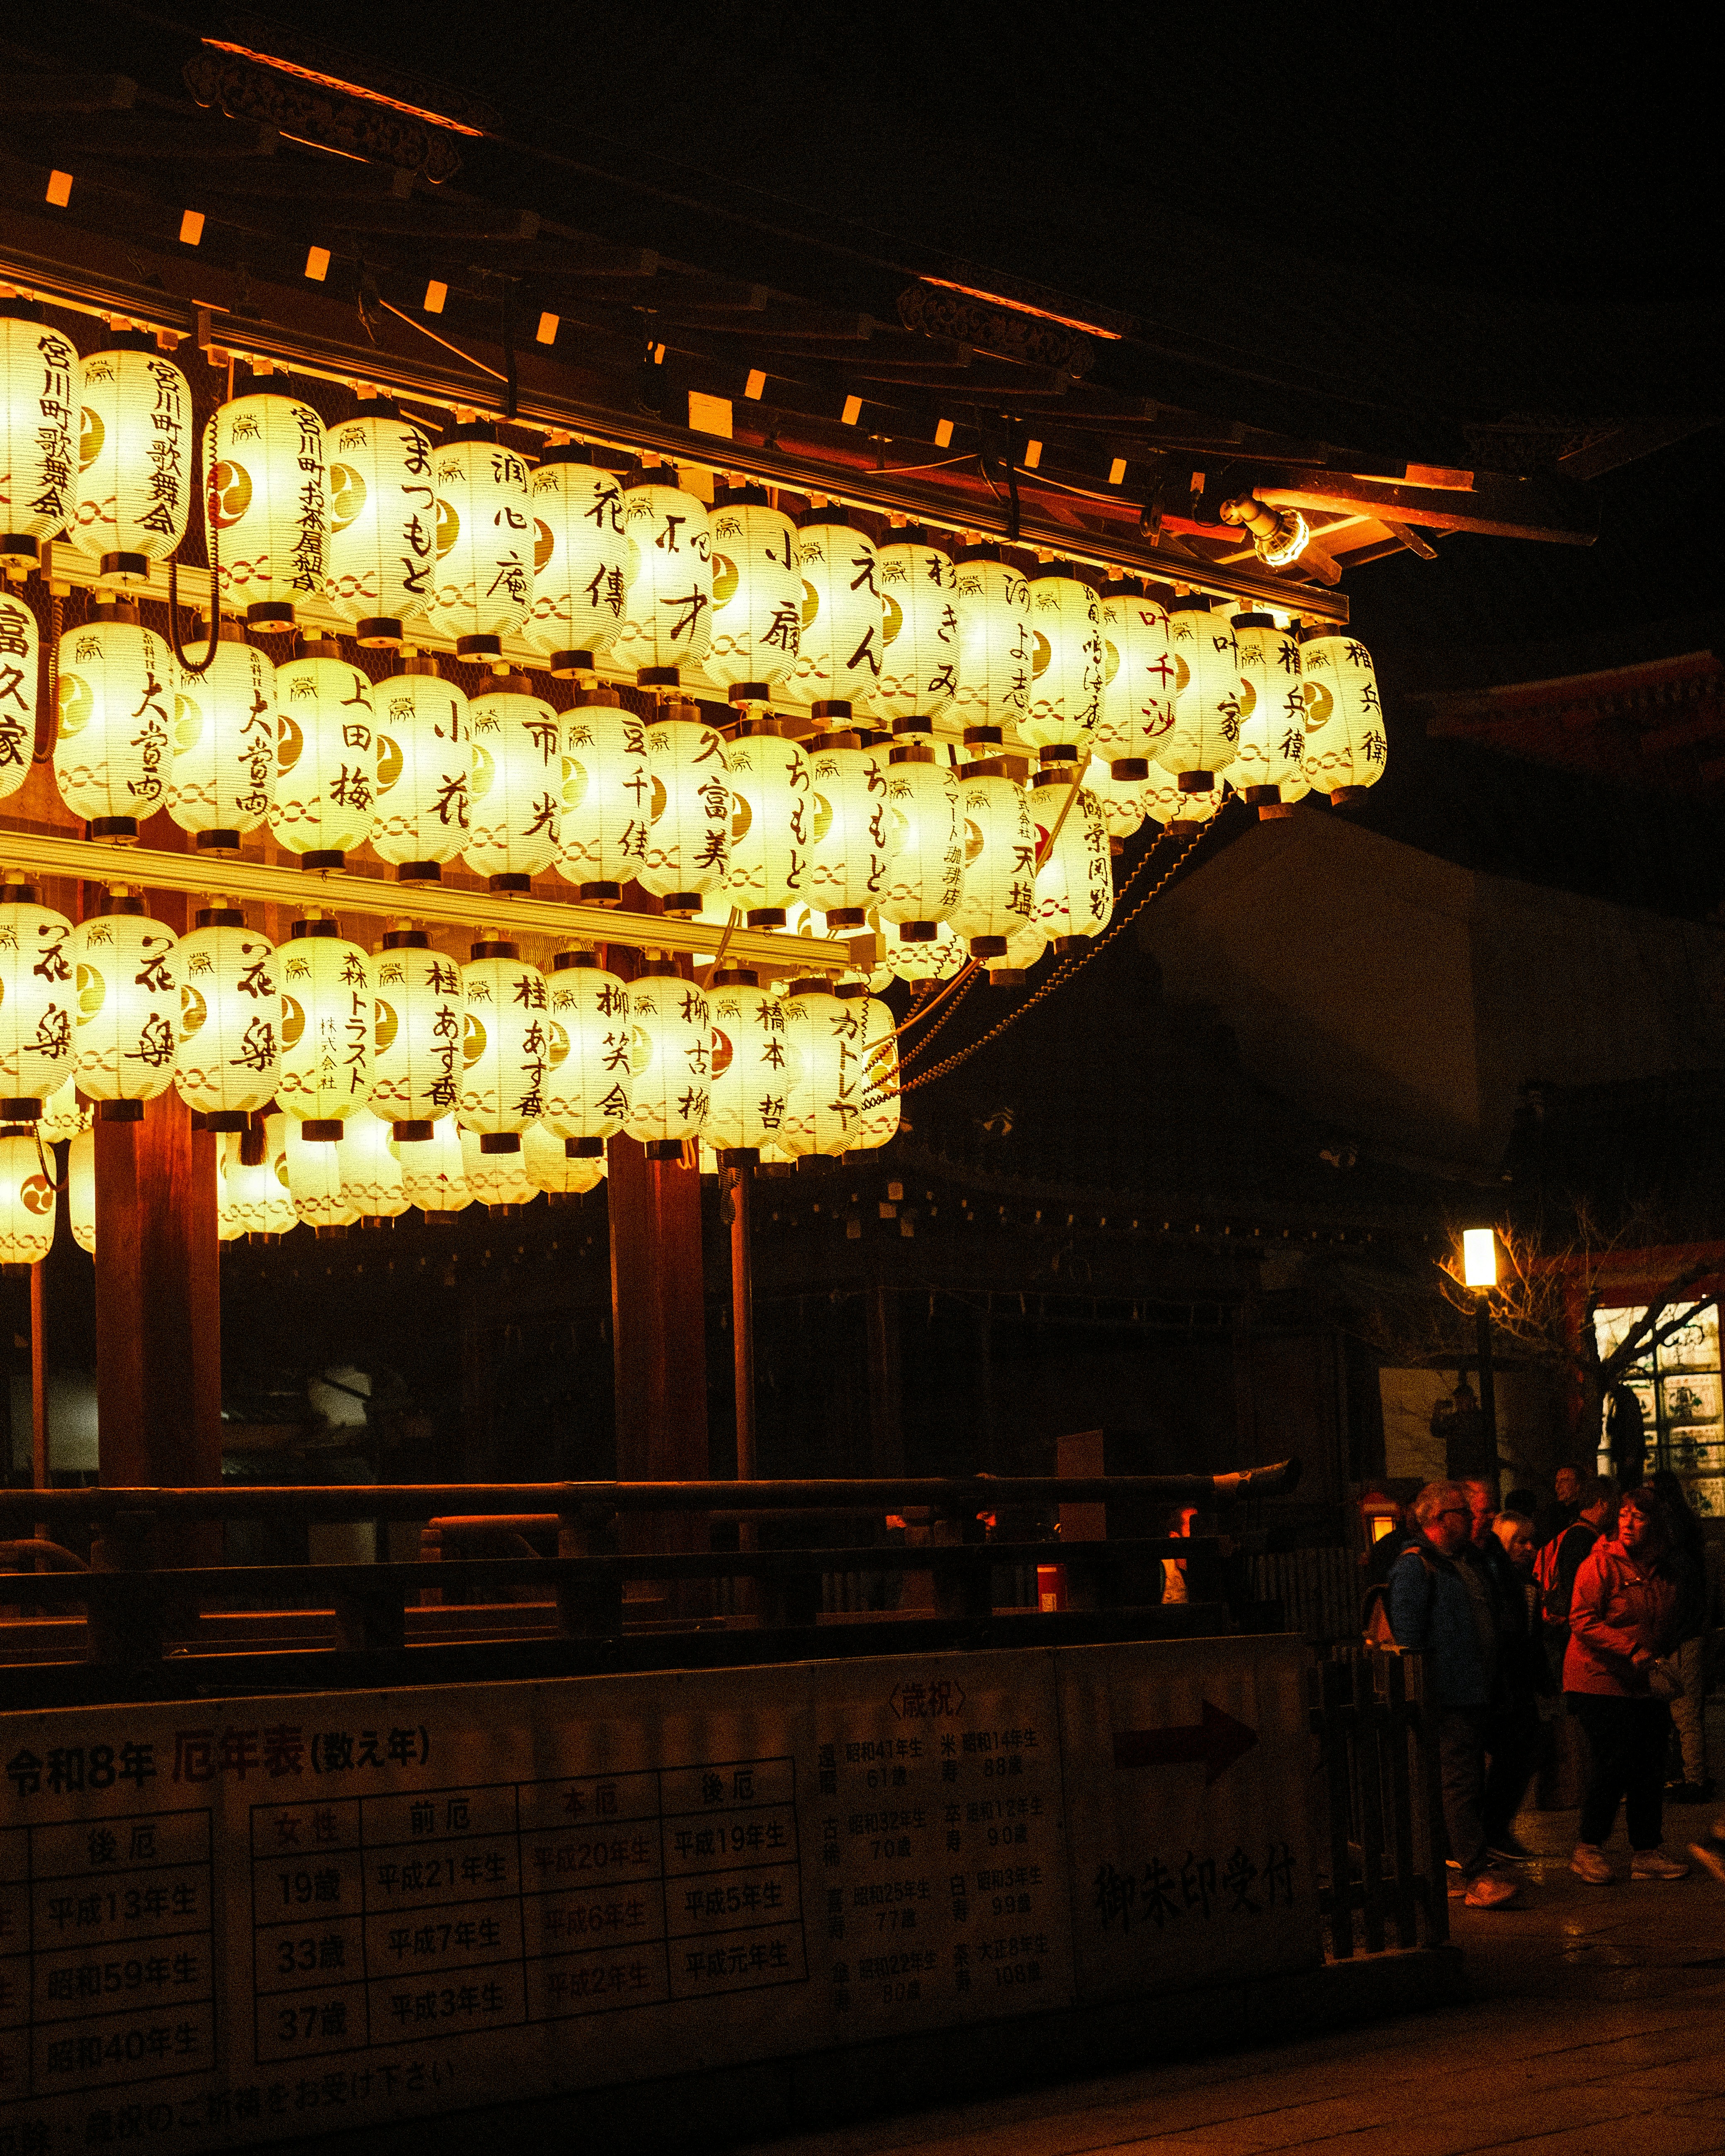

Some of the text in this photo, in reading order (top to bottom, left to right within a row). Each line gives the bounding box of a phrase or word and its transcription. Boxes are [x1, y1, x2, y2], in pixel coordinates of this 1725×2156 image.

[25, 335, 73, 518] 宮川町歌舞会
[134, 361, 182, 536] 宮川町歌舞会
[289, 406, 326, 592] 宮川町お茶屋組合
[398, 428, 435, 595] まつもと
[759, 527, 800, 659] 小扇
[845, 544, 883, 677] えん
[1138, 607, 1176, 738] 叶千沙
[329, 673, 374, 811] 上田梅
[428, 700, 470, 829] 小花
[521, 710, 560, 845] 市光
[691, 731, 732, 875] 久富美
[938, 772, 962, 906] スマート珈琲店
[338, 952, 368, 1095] 森トラスト
[420, 960, 460, 1107] 桂あす香
[319, 1017, 337, 1090] 株式会社
[511, 975, 548, 1119] 桂あす香
[594, 983, 631, 1120] 柳笑会
[756, 998, 786, 1130] 橋本哲
[827, 1007, 859, 1131] カトレヤ
[6, 1724, 430, 1798] 令和8年 厄年表 (数え年)
[845, 1737, 924, 1763] 昭和41年生
[962, 1727, 1039, 1753] 昭和14年生
[866, 1765, 907, 1789] 61歳
[983, 1754, 1023, 1777] 88歳
[562, 1783, 618, 1820] 本厄
[702, 1770, 754, 1804] 後厄
[274, 1808, 339, 1845] 女性
[410, 1798, 471, 1835] 前厄
[848, 1808, 927, 1836] 昭和32年生
[966, 1795, 1044, 1822] 昭和12年生
[87, 1824, 157, 1865] 後厄
[674, 1820, 787, 1860] 平成19年生
[870, 1836, 911, 1860] 70歳
[987, 1823, 1028, 1846] 90歳
[377, 1852, 507, 1894] 平成21年生
[535, 1835, 651, 1877] 平成20年生
[278, 1867, 341, 1904] 19歳
[853, 1877, 931, 1907] 昭和25年生
[977, 1865, 1043, 1891] 昭和3年生
[1095, 1841, 1297, 1935] 御朱印受付
[49, 1882, 198, 1928] 平成13年生
[544, 1899, 646, 1941] 平成6年生
[685, 1880, 784, 1920] 平成5年生
[876, 1908, 916, 1931] 77歳
[992, 1892, 1032, 1916] 99歳
[277, 1934, 345, 1974] 33歳
[389, 1917, 501, 1959] 平成7年生
[978, 1933, 1049, 1962] 大正8年生
[48, 1952, 198, 2000] 昭和59年生
[685, 1939, 790, 1981] 平成元年生
[859, 1950, 938, 1980] 昭和22年生
[547, 1960, 651, 2003] 平成2年生
[277, 2001, 347, 2041] 37歳
[391, 1981, 503, 2025] 平成3年生
[47, 2021, 199, 2073] 昭和40年生
